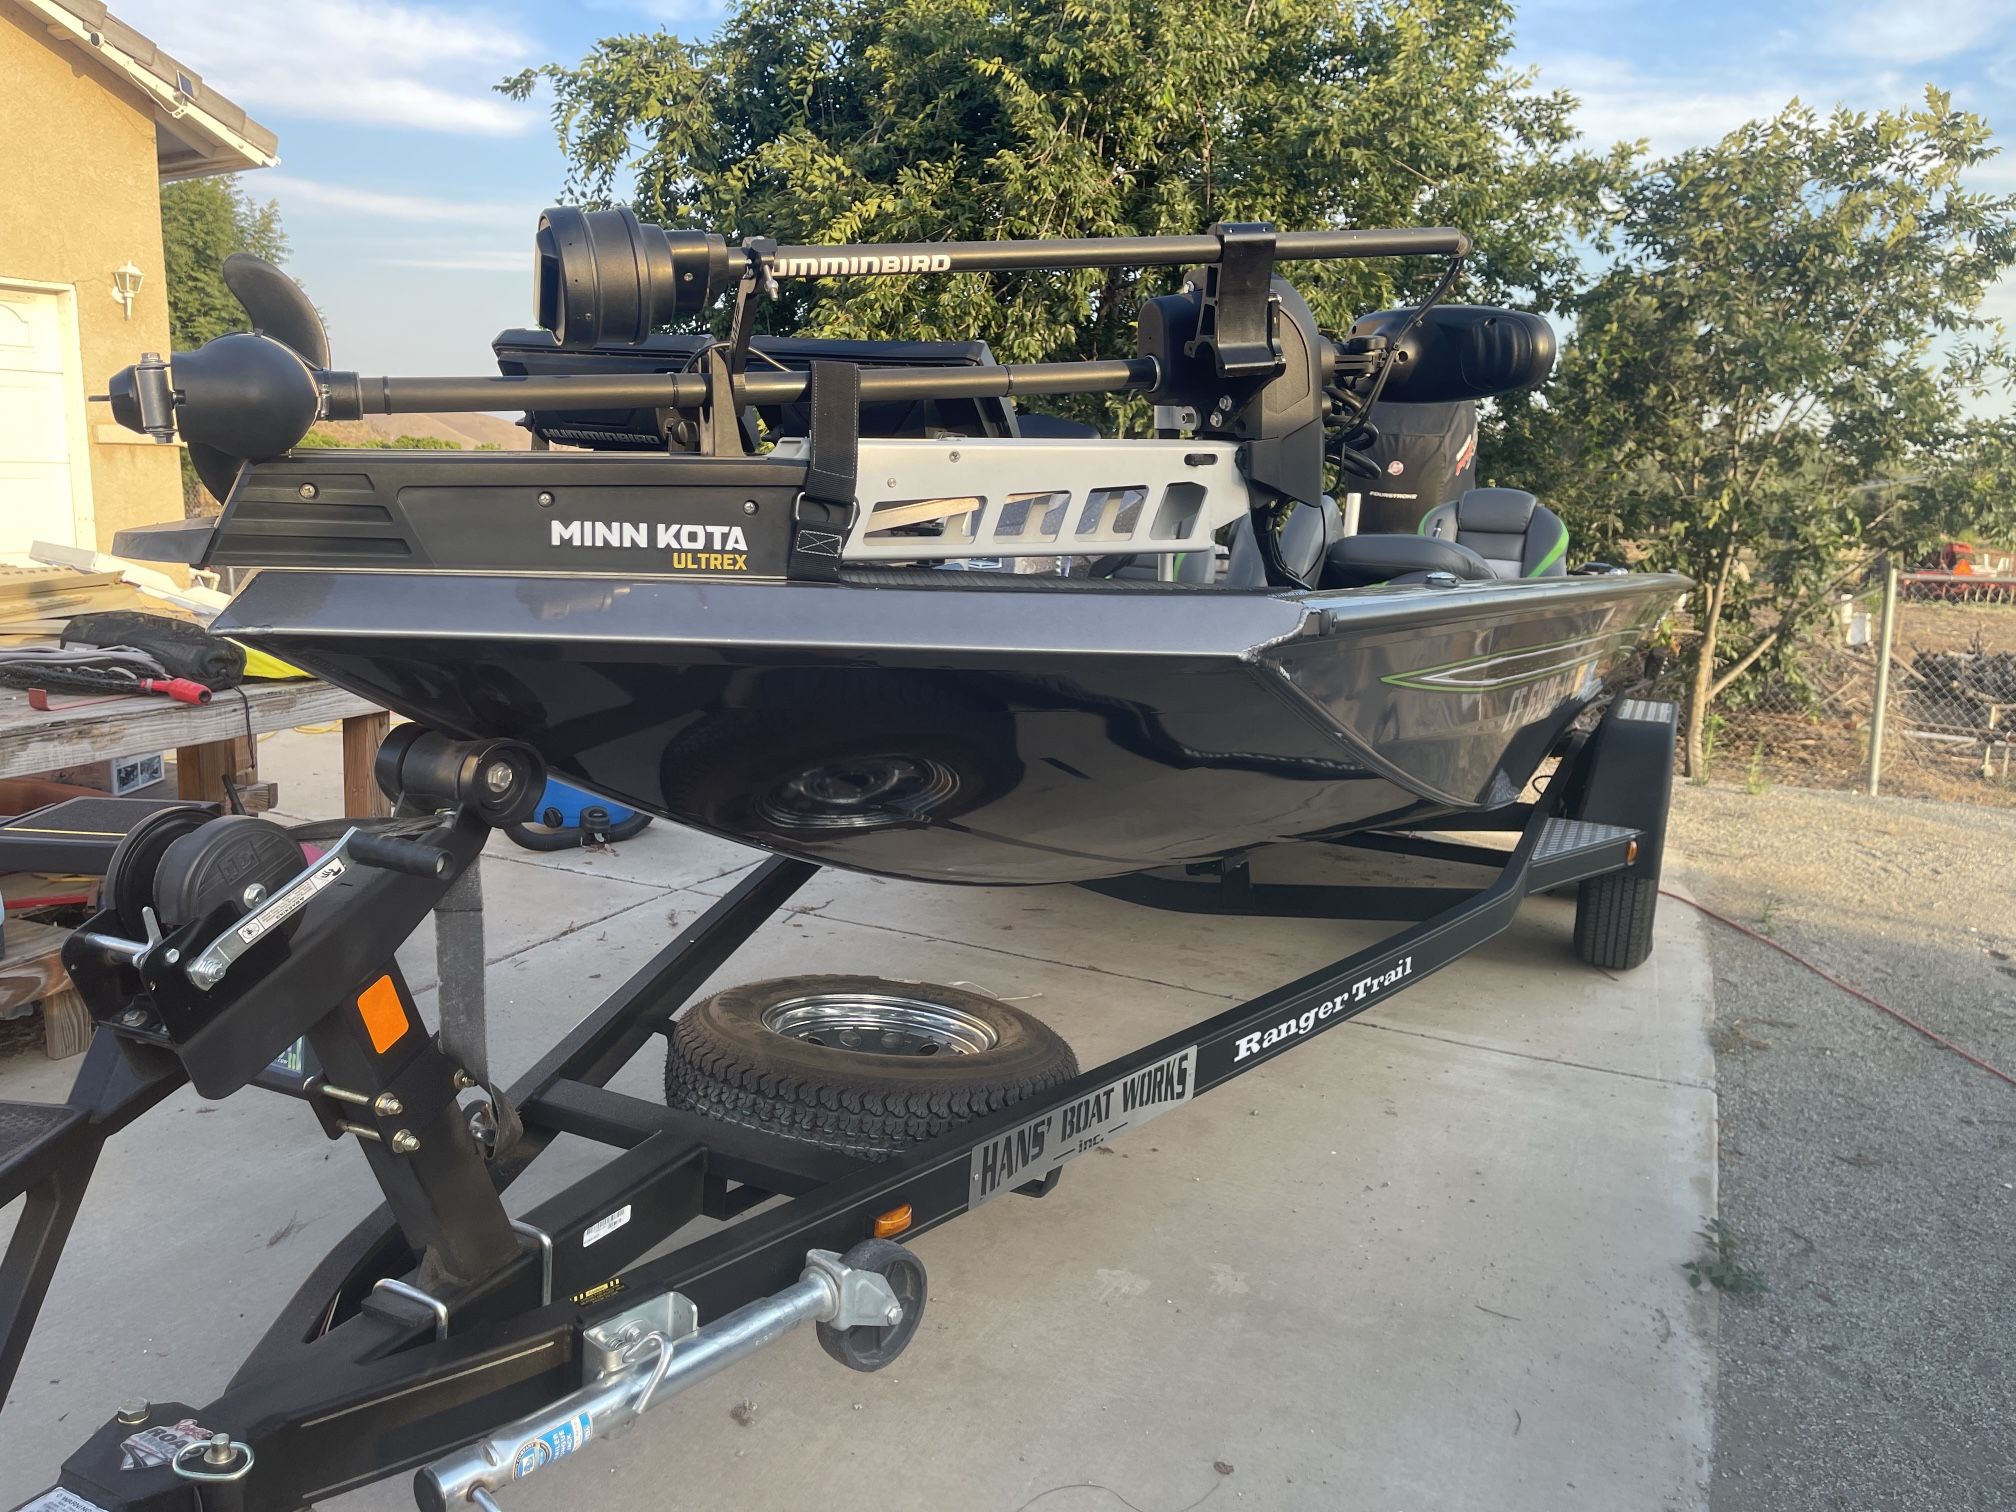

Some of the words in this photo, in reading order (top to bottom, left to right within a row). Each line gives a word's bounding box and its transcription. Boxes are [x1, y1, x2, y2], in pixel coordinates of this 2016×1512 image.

[773, 254, 951, 277] UMMINBIRD
[542, 428, 660, 445] HUMMINBIRD
[551, 520, 648, 548] MINN
[657, 523, 748, 551] KOTA
[673, 552, 748, 571] ULTREX
[1233, 992, 1349, 1063] Ranger
[1352, 956, 1413, 1002] Trail
[981, 1116, 1052, 1197] HANS'
[1061, 1087, 1114, 1143] BOAT
[1122, 1052, 1189, 1113] WORKS
[1078, 1134, 1105, 1153] inc.
